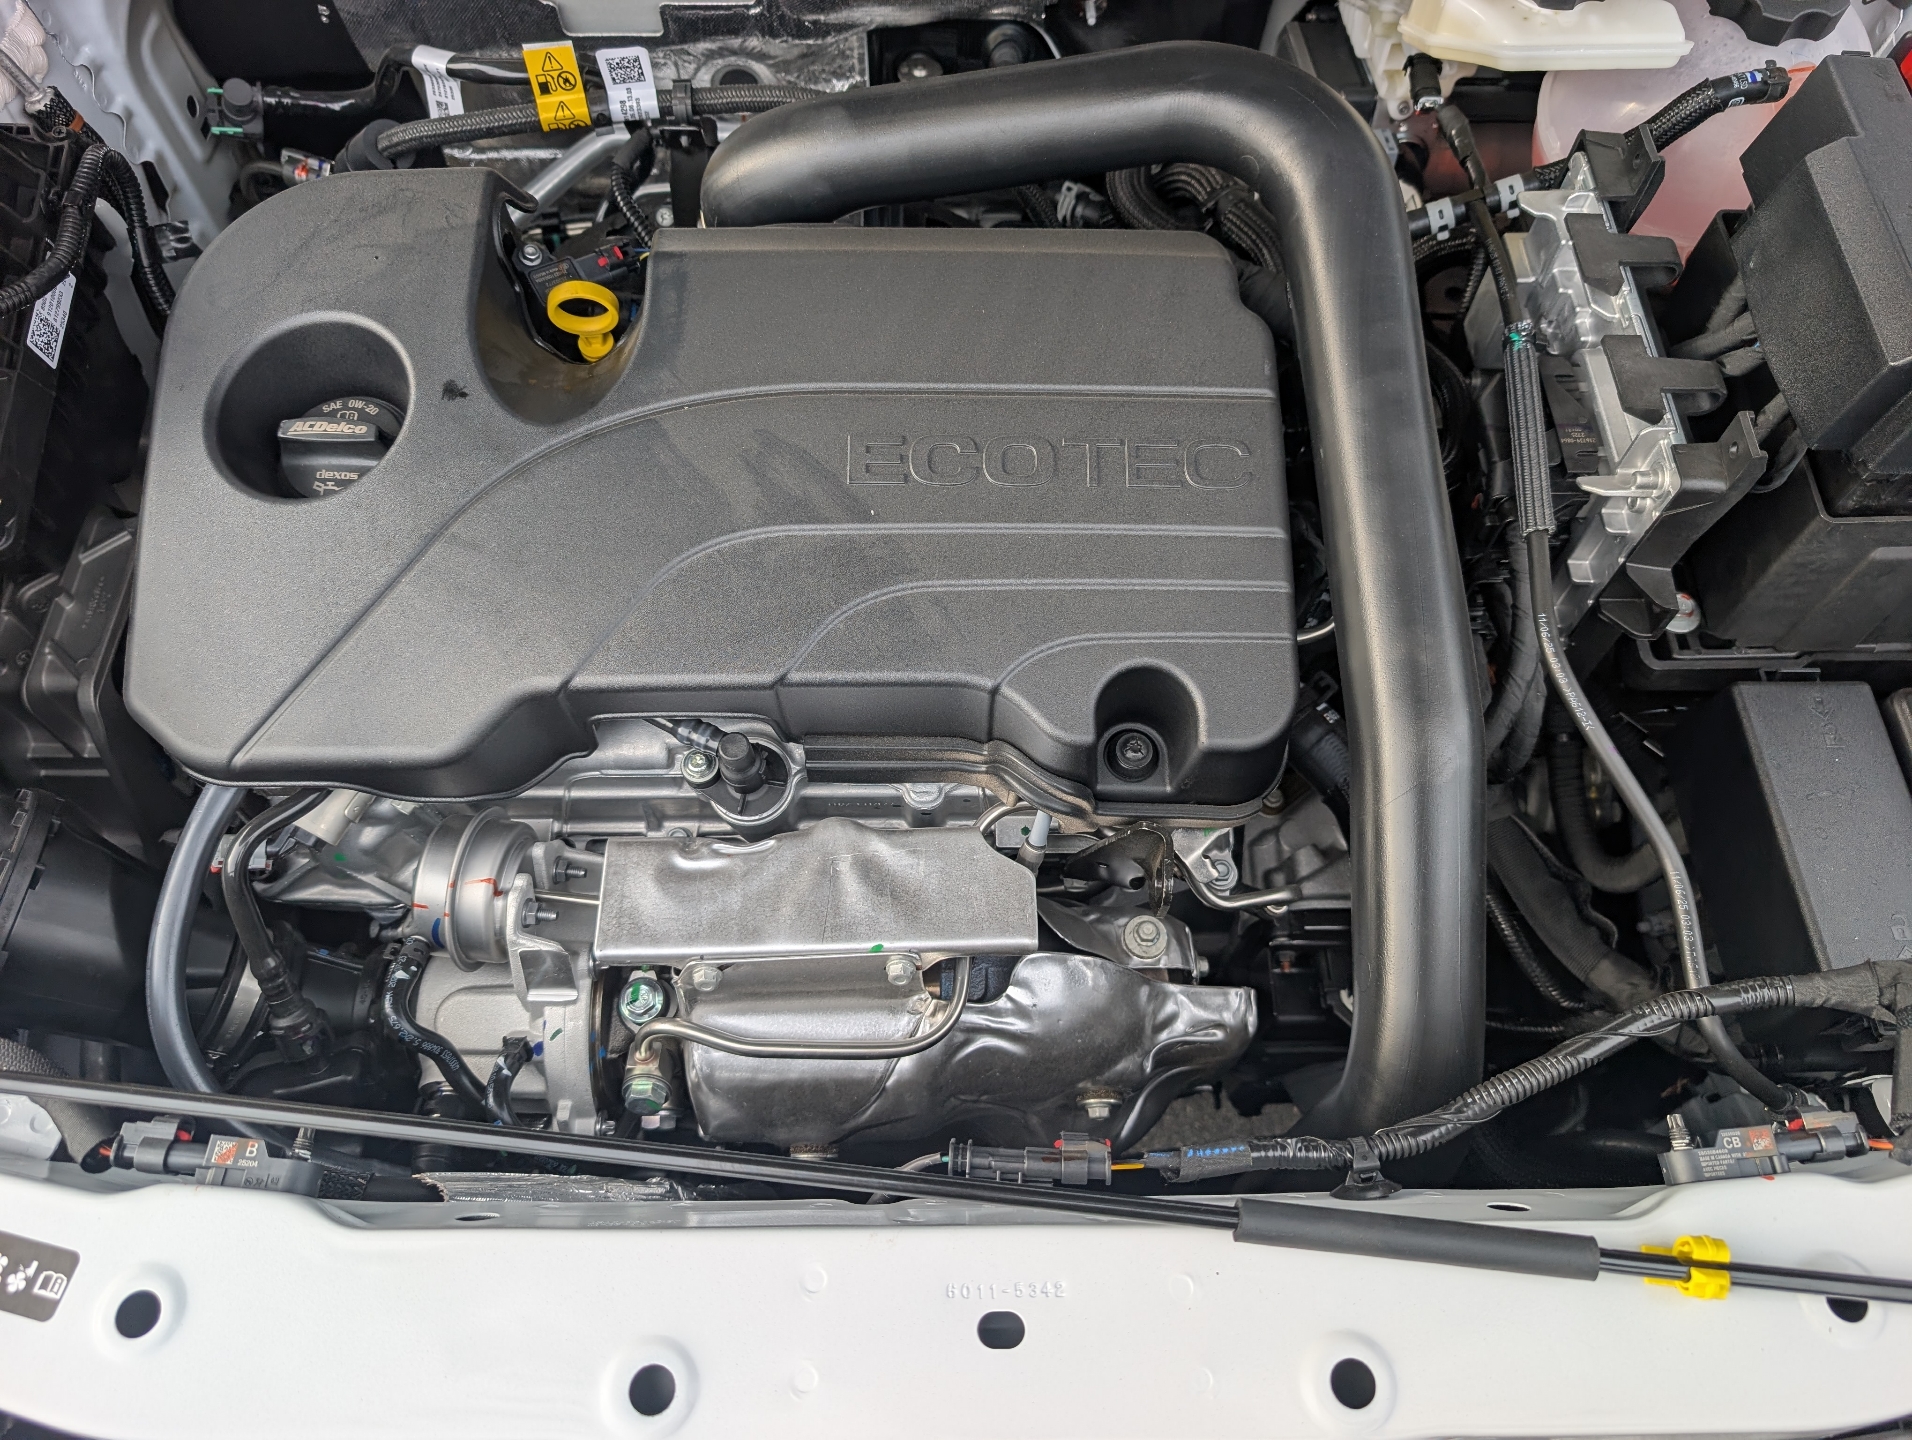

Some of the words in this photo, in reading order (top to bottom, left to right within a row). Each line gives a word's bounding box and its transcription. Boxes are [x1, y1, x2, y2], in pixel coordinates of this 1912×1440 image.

[322, 400, 342, 413] SAE
[348, 400, 380, 416] 0W-20
[288, 421, 368, 434] ACDelco
[847, 434, 1253, 490] ECOTEC
[316, 469, 360, 480] dexos
[246, 1141, 258, 1157] B
[1724, 1136, 1742, 1148] CB
[238, 1158, 258, 1168] 25204
[946, 1280, 1066, 1300] 6011-5342
